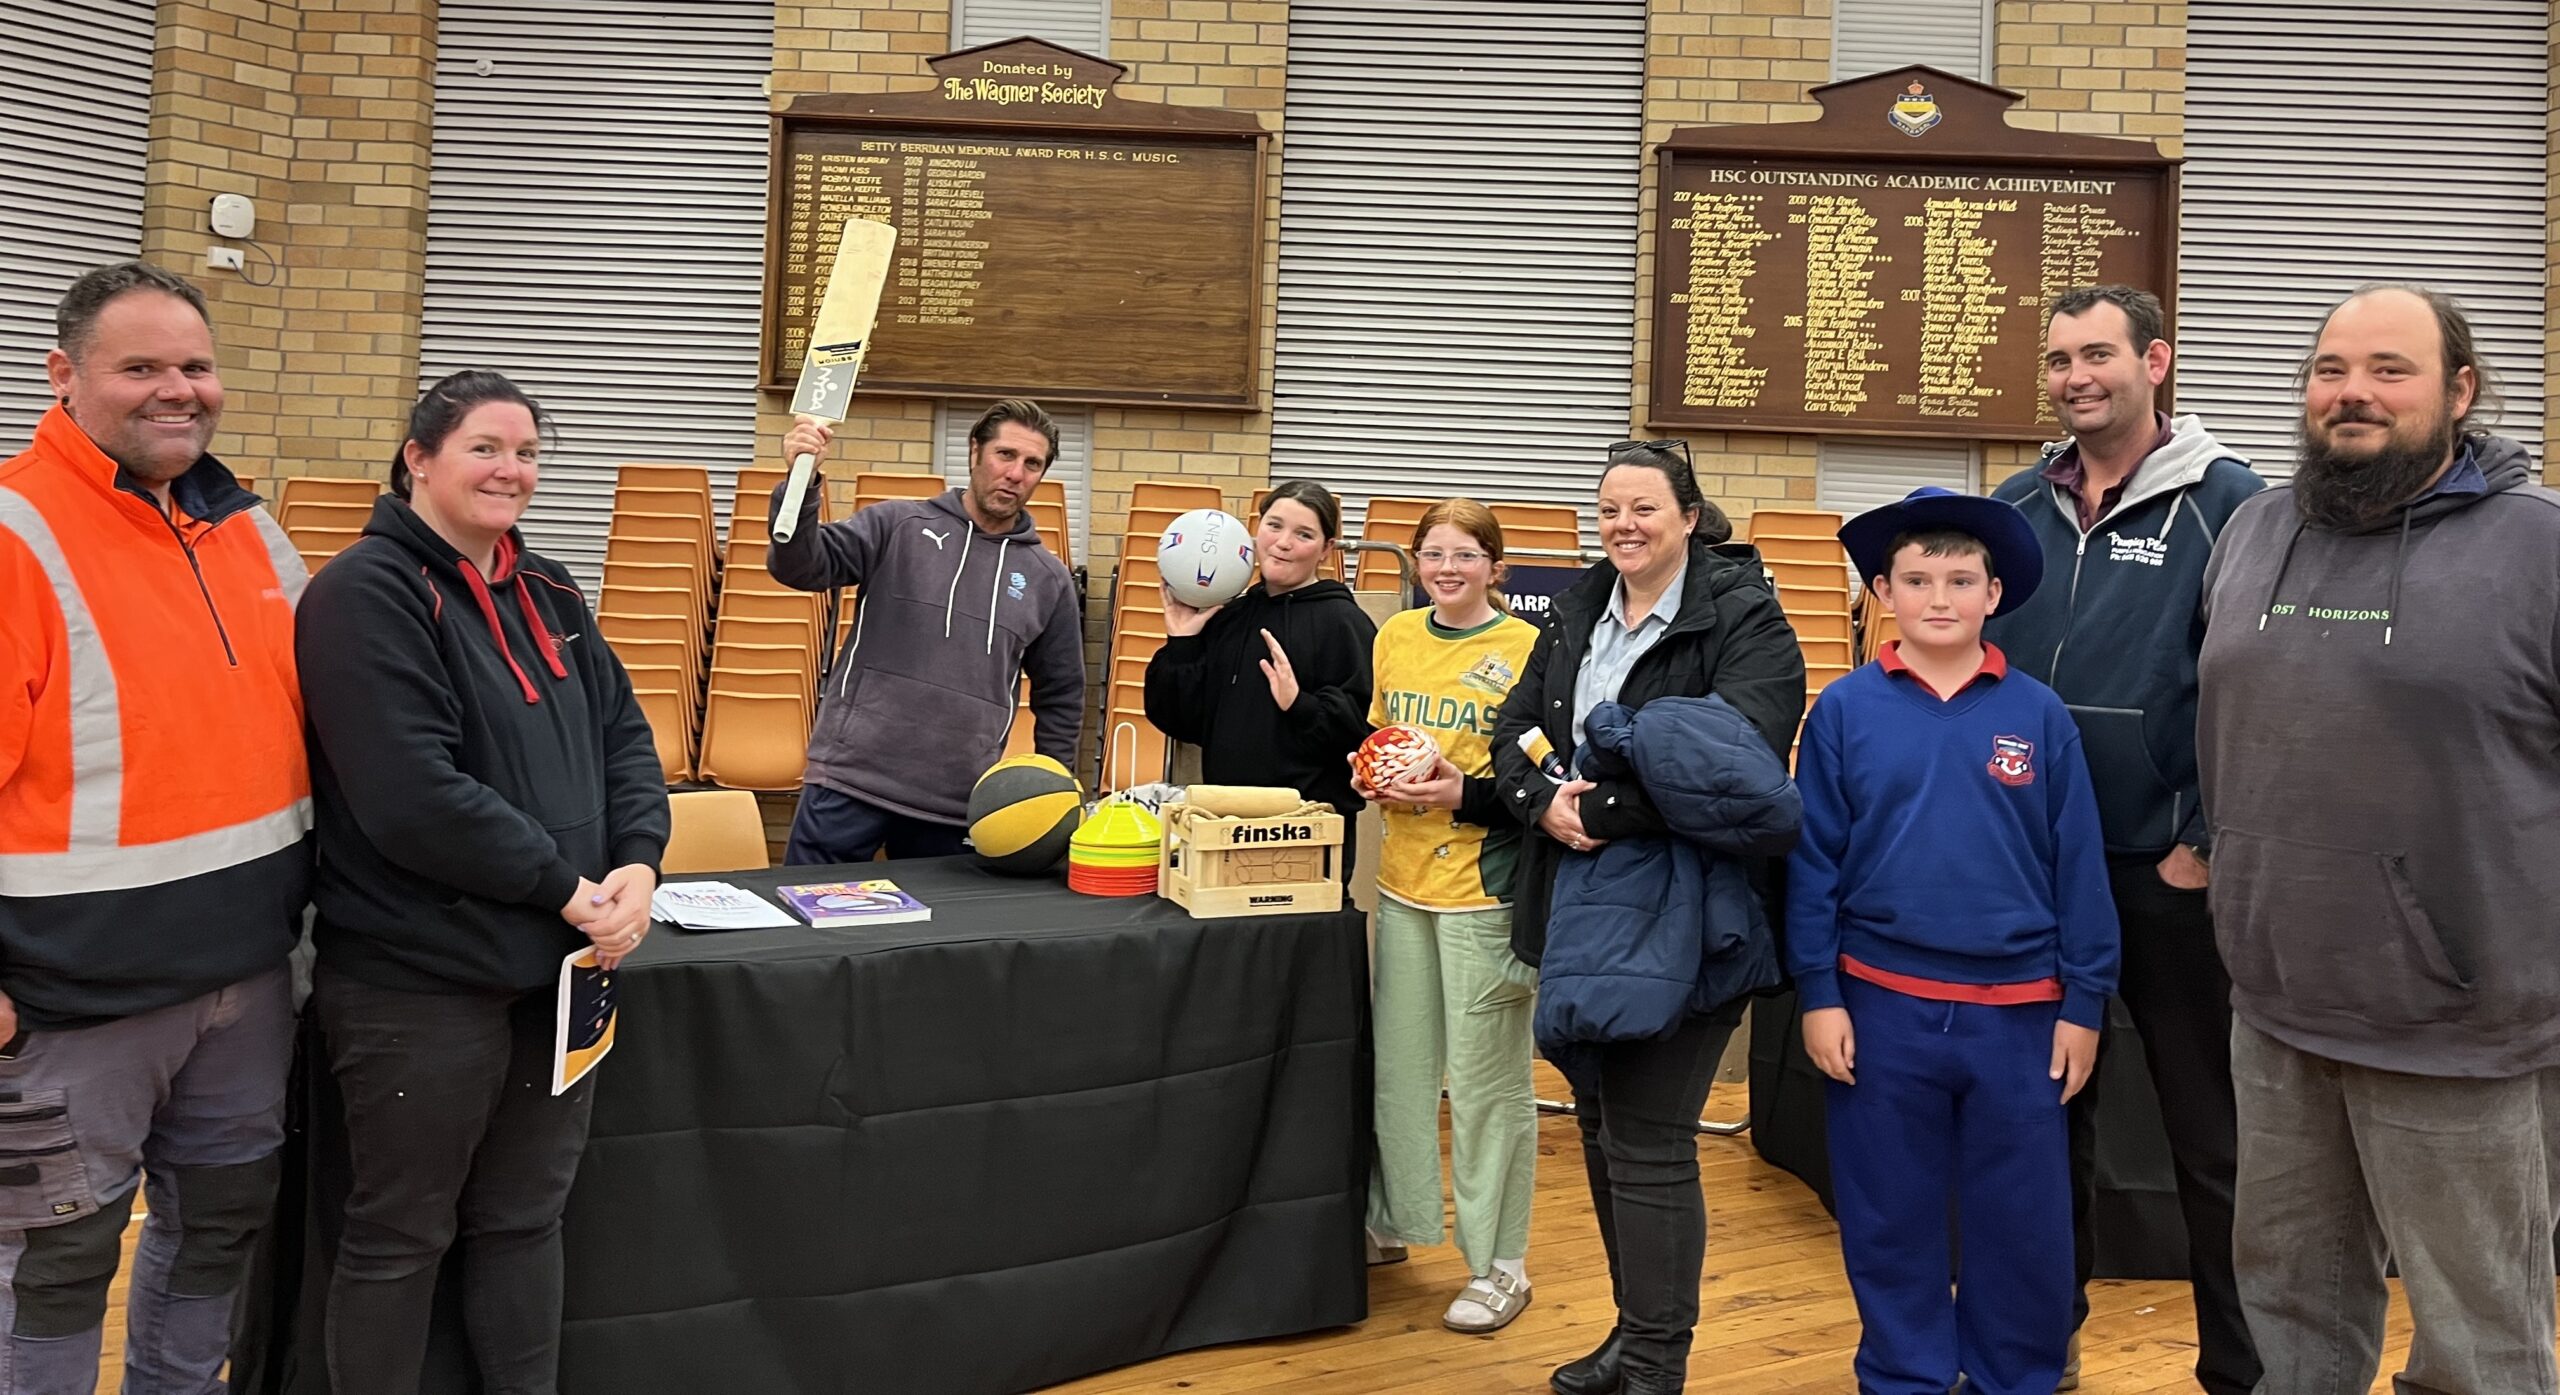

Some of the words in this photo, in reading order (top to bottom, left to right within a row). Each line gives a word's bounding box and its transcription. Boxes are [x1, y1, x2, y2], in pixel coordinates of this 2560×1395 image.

[983, 61, 1047, 75] Donated
[1053, 64, 1073, 79] by
[943, 77, 974, 101] The
[970, 79, 1039, 105] Wagner
[1040, 81, 1108, 109] Society
[861, 141, 897, 152] BETTY
[900, 143, 955, 154] BERRIMAN
[957, 145, 1012, 157] MEMORIAL
[1016, 147, 1053, 158] AWARD
[1057, 149, 1081, 160] FOR
[1710, 169, 1747, 184] HSC
[1750, 170, 1878, 188] OUTSTANDING
[1884, 175, 1980, 191] ACADEMIC
[1984, 177, 2116, 195] ACHIEVEMENT
[1828, 401, 1857, 417] Tough
[1201, 523, 1220, 555] NHS
[2308, 607, 2390, 620] HORIZONS
[1232, 823, 1311, 844] finska
[1249, 895, 1293, 904] WARNING
